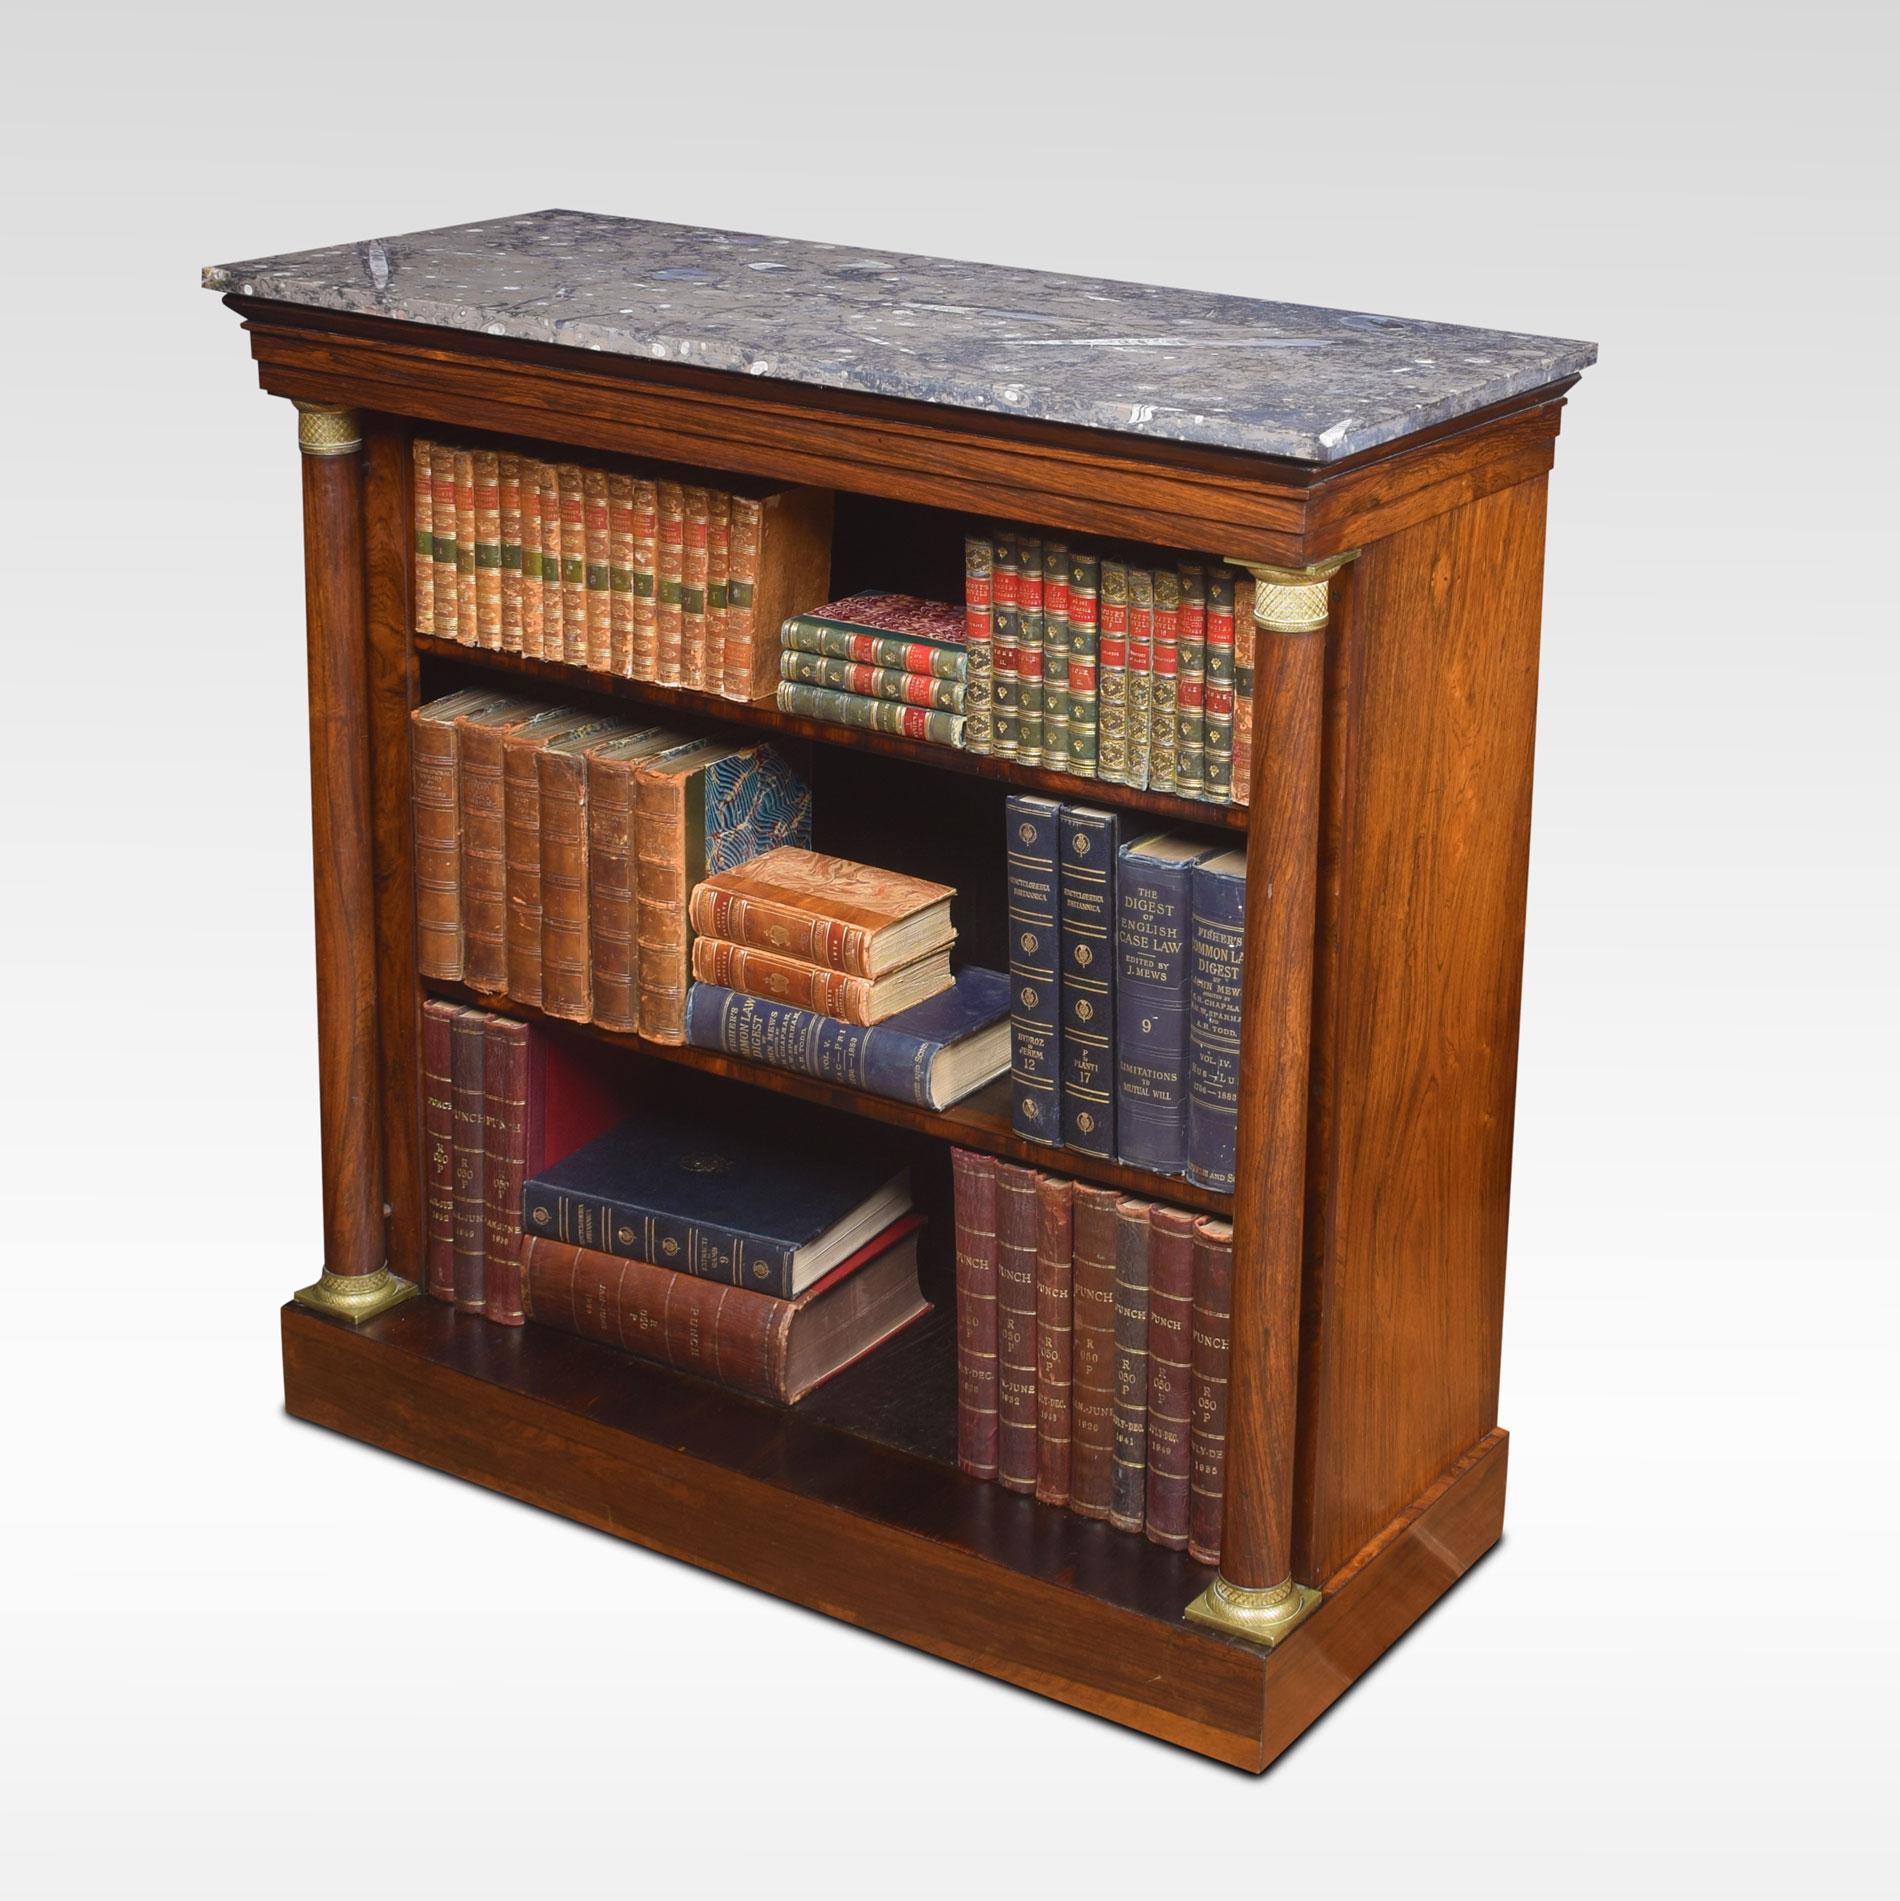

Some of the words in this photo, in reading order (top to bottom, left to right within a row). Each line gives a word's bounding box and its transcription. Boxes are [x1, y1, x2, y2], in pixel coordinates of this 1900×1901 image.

[1138, 887, 1158, 899] THE
[1125, 896, 1175, 916] DIGEST
[1142, 913, 1154, 921] OF
[1120, 917, 1177, 938] ENGLISH
[1120, 931, 1149, 948] CASE
[1153, 938, 1182, 953] LAW
[1126, 955, 1154, 967] EDITED
[1158, 962, 1170, 971] BY
[1198, 958, 1240, 980] DIGEST
[1217, 985, 1241, 997] MEW
[742, 997, 756, 1022] LAW
[1204, 998, 1240, 1012] CHAPMA
[767, 1010, 779, 1041] MEWS
[1142, 1018, 1152, 1033] 9
[751, 1015, 764, 1058] DIGEST
[1024, 1058, 1036, 1071] 12
[1200, 1052, 1217, 1065] VOL.
[1219, 1059, 1232, 1068] IV.
[1080, 1071, 1091, 1083] 17
[1120, 1061, 1178, 1082] LIMITATIONS
[1123, 1082, 1151, 1096] MUTUAL
[1152, 1089, 1172, 1100] WILL
[461, 1158, 468, 1168] R
[462, 1179, 469, 1190] P
[719, 1255, 729, 1265] 9
[1074, 1282, 1113, 1303] PUNCH
[1115, 1303, 1147, 1320] PUNCH
[1007, 1319, 1015, 1330] R
[1151, 1312, 1182, 1331] PUNCH
[690, 1307, 700, 1357] PUNCH
[1003, 1328, 1021, 1343] 050
[1008, 1342, 1014, 1353] P
[1045, 1337, 1053, 1348] R
[1086, 1338, 1094, 1349] R
[1041, 1347, 1058, 1361] 050
[1080, 1349, 1099, 1363] 050
[1046, 1362, 1053, 1372] P
[1122, 1359, 1130, 1370] R
[1118, 1370, 1136, 1384] 050
[1158, 1367, 1166, 1379] R
[1122, 1385, 1130, 1395] P
[1153, 1378, 1171, 1392] 050
[1203, 1386, 1211, 1398] R
[1158, 1393, 1166, 1404] P
[1198, 1396, 1217, 1411] 050
[1203, 1412, 1211, 1422] P
